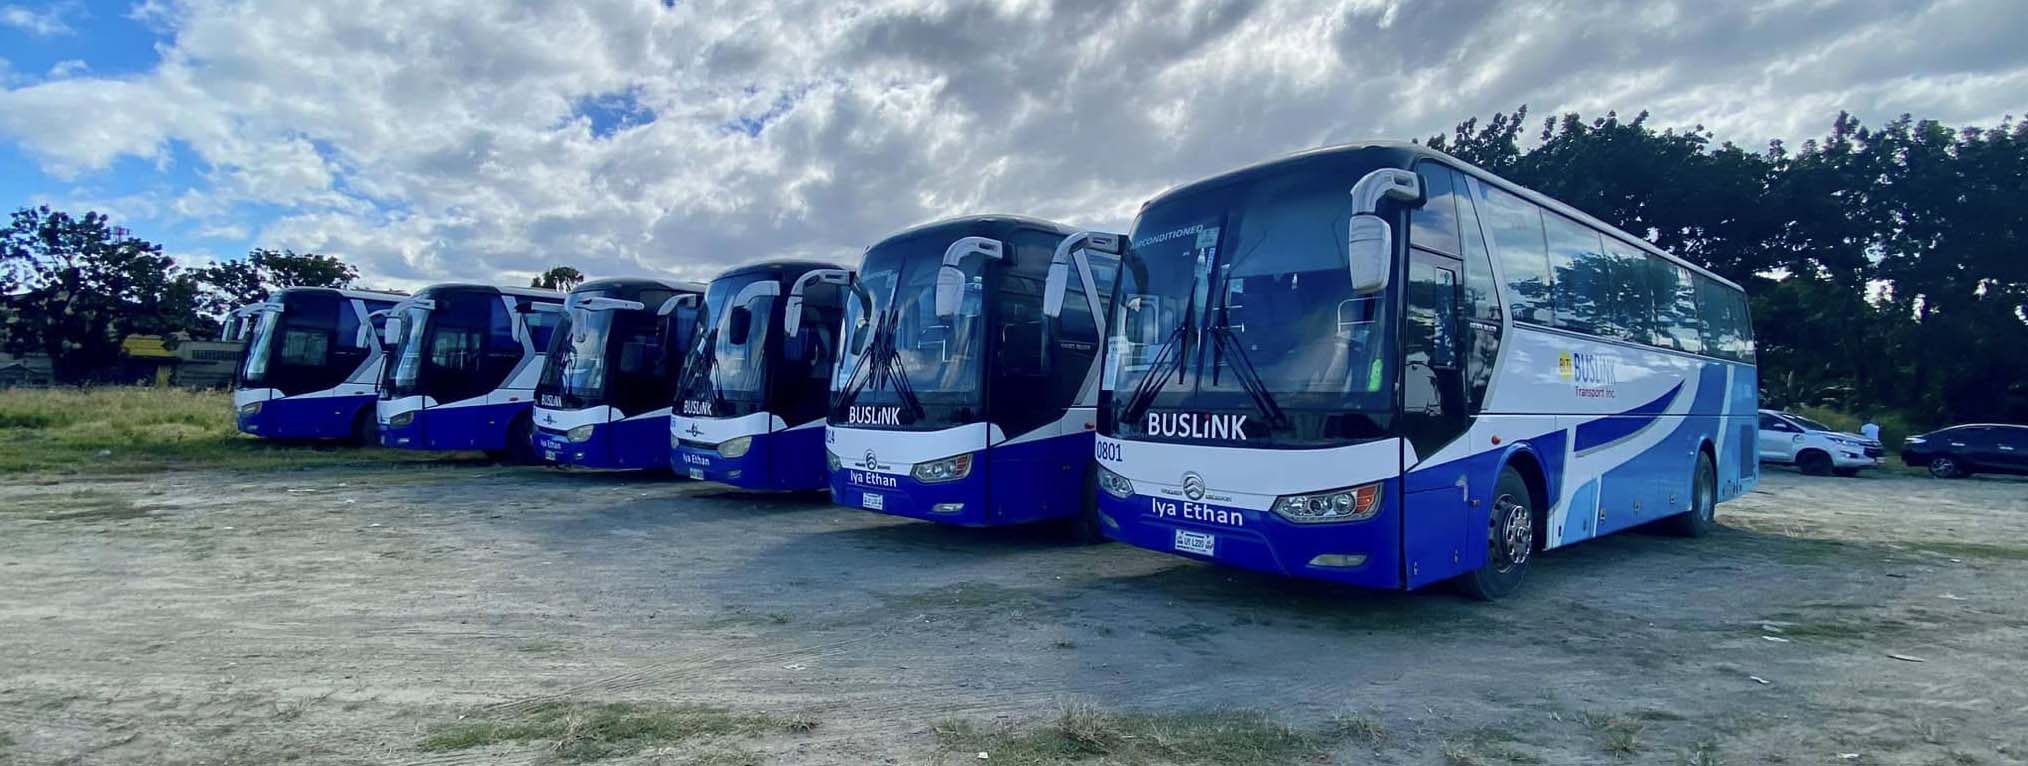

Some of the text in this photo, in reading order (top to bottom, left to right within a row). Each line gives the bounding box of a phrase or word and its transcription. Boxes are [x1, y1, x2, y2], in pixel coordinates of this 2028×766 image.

[691, 454, 710, 467] Ethan
[1096, 441, 1123, 463] 0801
[850, 469, 897, 488] Iya Ethan
[1152, 497, 1243, 527] Iya Ethan
